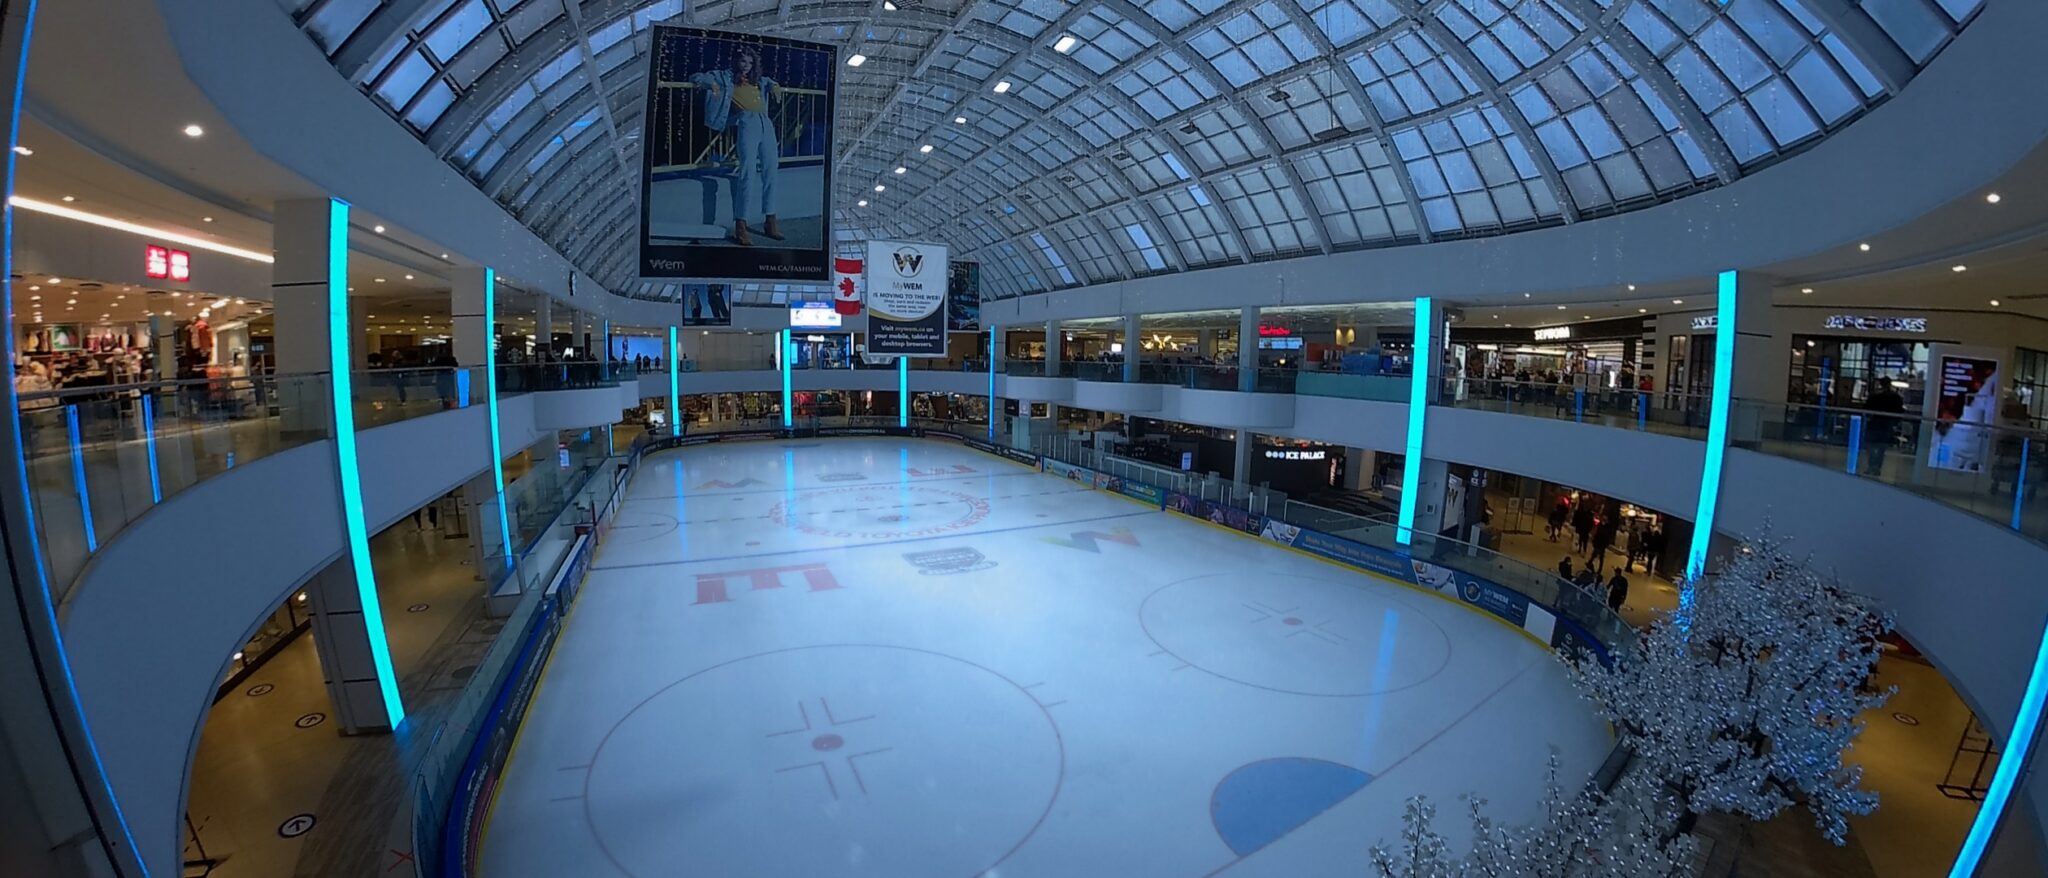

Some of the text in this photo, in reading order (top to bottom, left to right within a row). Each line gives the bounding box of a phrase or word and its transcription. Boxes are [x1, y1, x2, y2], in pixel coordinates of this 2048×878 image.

[758, 264, 822, 273] WEM.CA/FASHION
[892, 282, 923, 291] MyWEM
[881, 340, 906, 348] desktop
[1286, 451, 1325, 460] ICE PALACE
